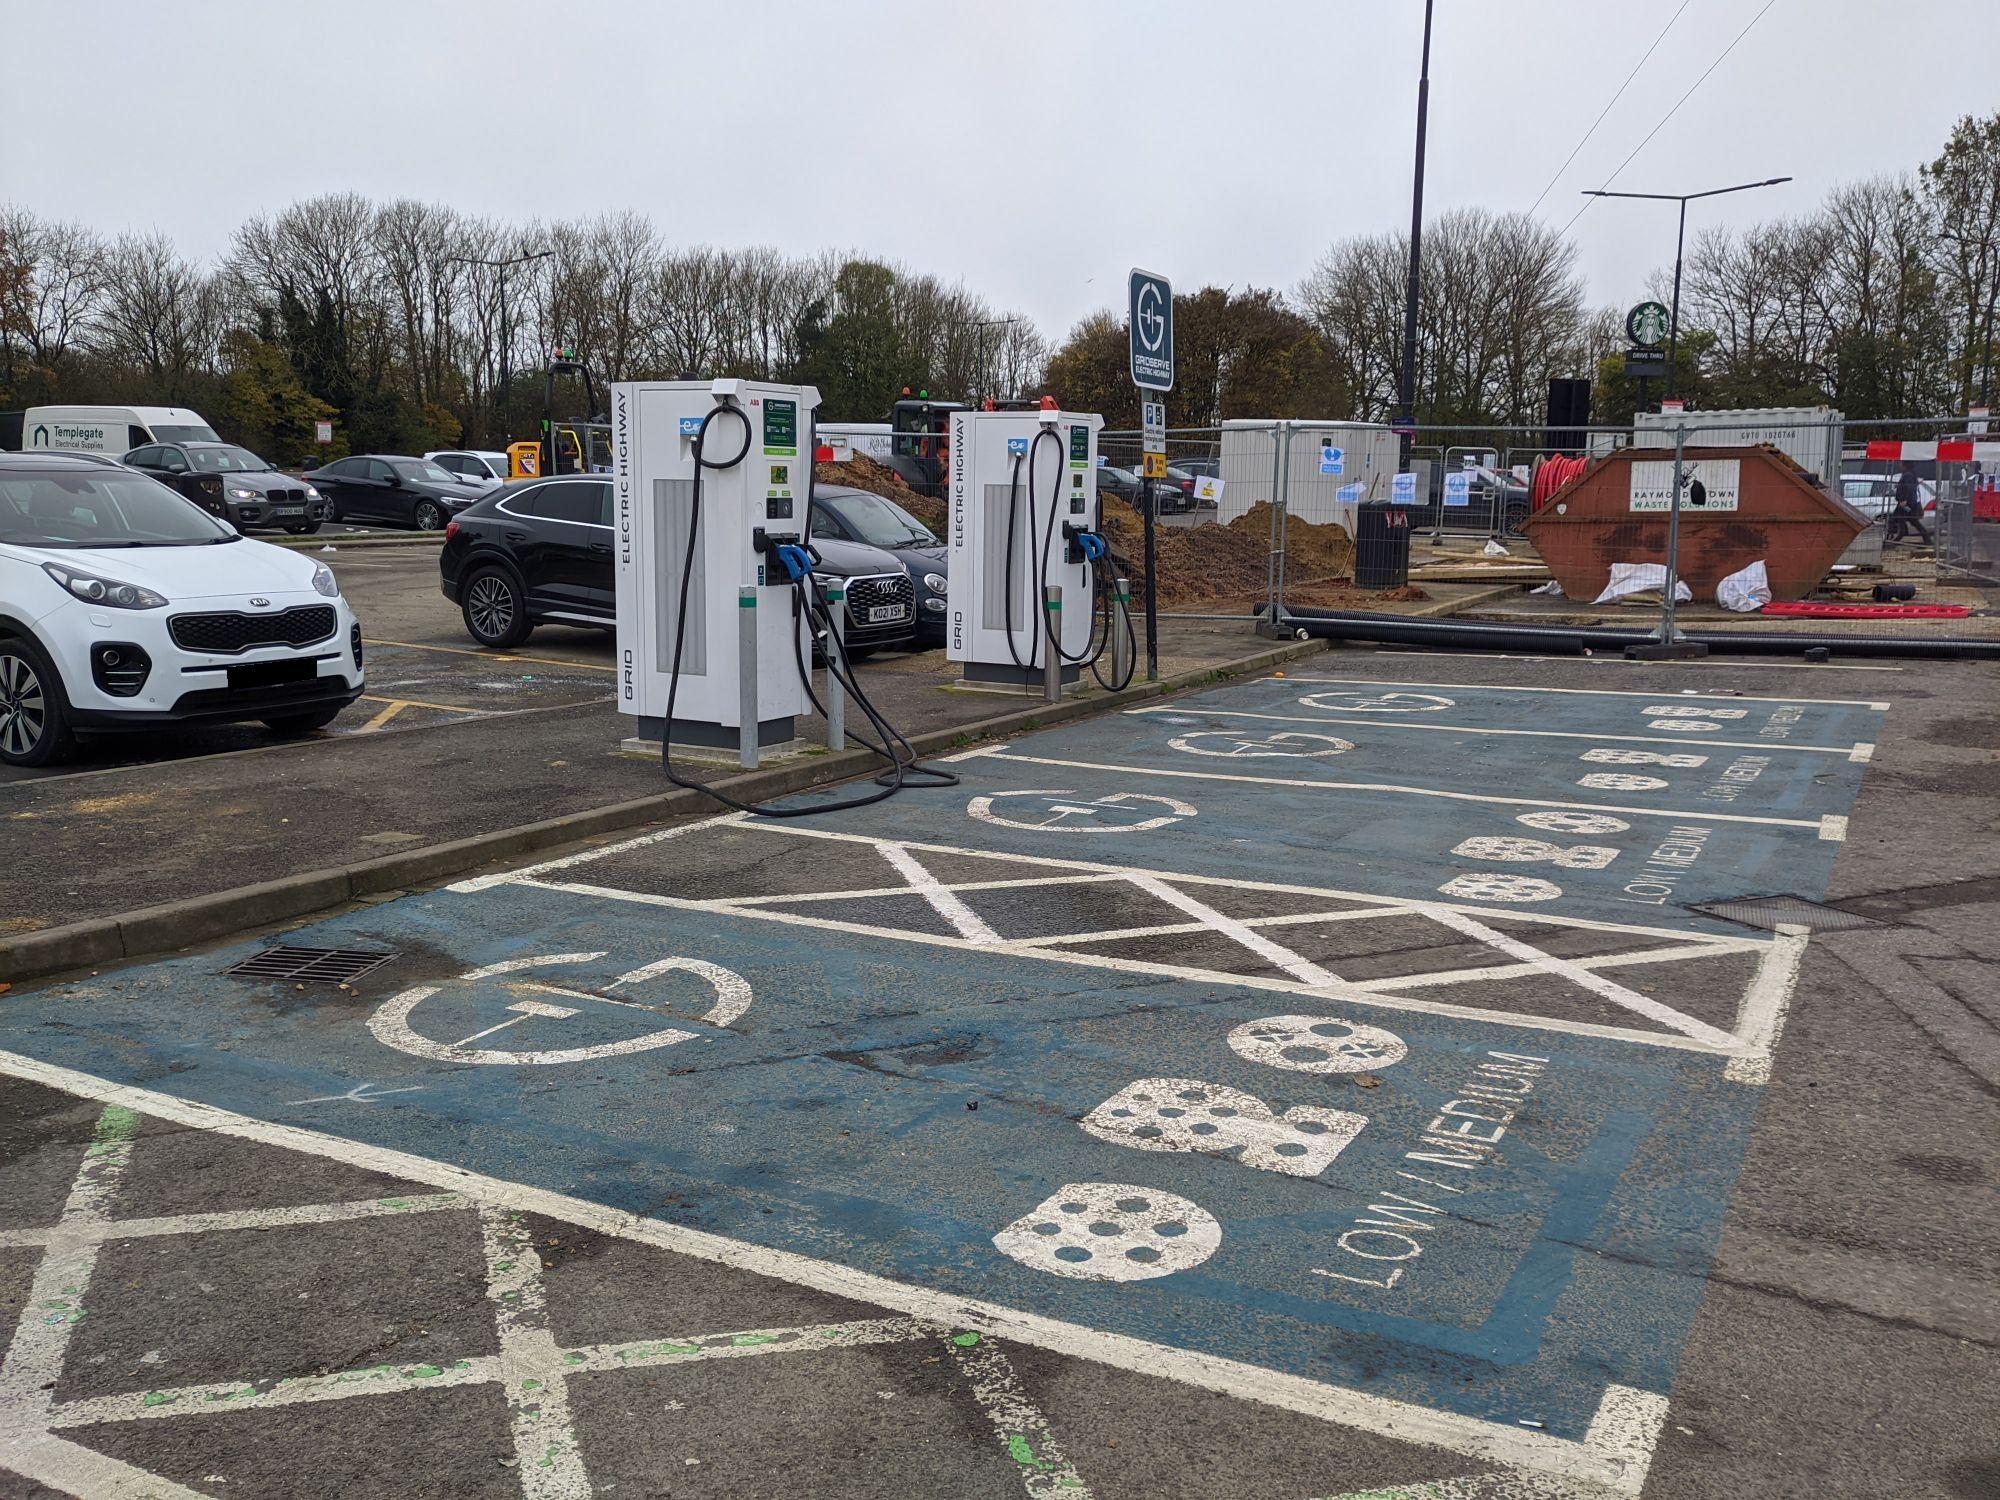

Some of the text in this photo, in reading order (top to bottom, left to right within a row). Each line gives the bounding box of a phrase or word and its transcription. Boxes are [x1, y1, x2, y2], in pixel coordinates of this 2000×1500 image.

[1135, 354, 1170, 371] GRIDSERVE
[54, 426, 104, 440] Templegate
[55, 440, 104, 450] Electrical Supplies
[618, 391, 630, 564] ELECTRIC HIGHWAY
[955, 417, 964, 547] ELECTRIC HIGHWAY
[1634, 490, 1689, 499] RAYMOD
[954, 611, 962, 650] GRID
[624, 649, 633, 701] GRID
